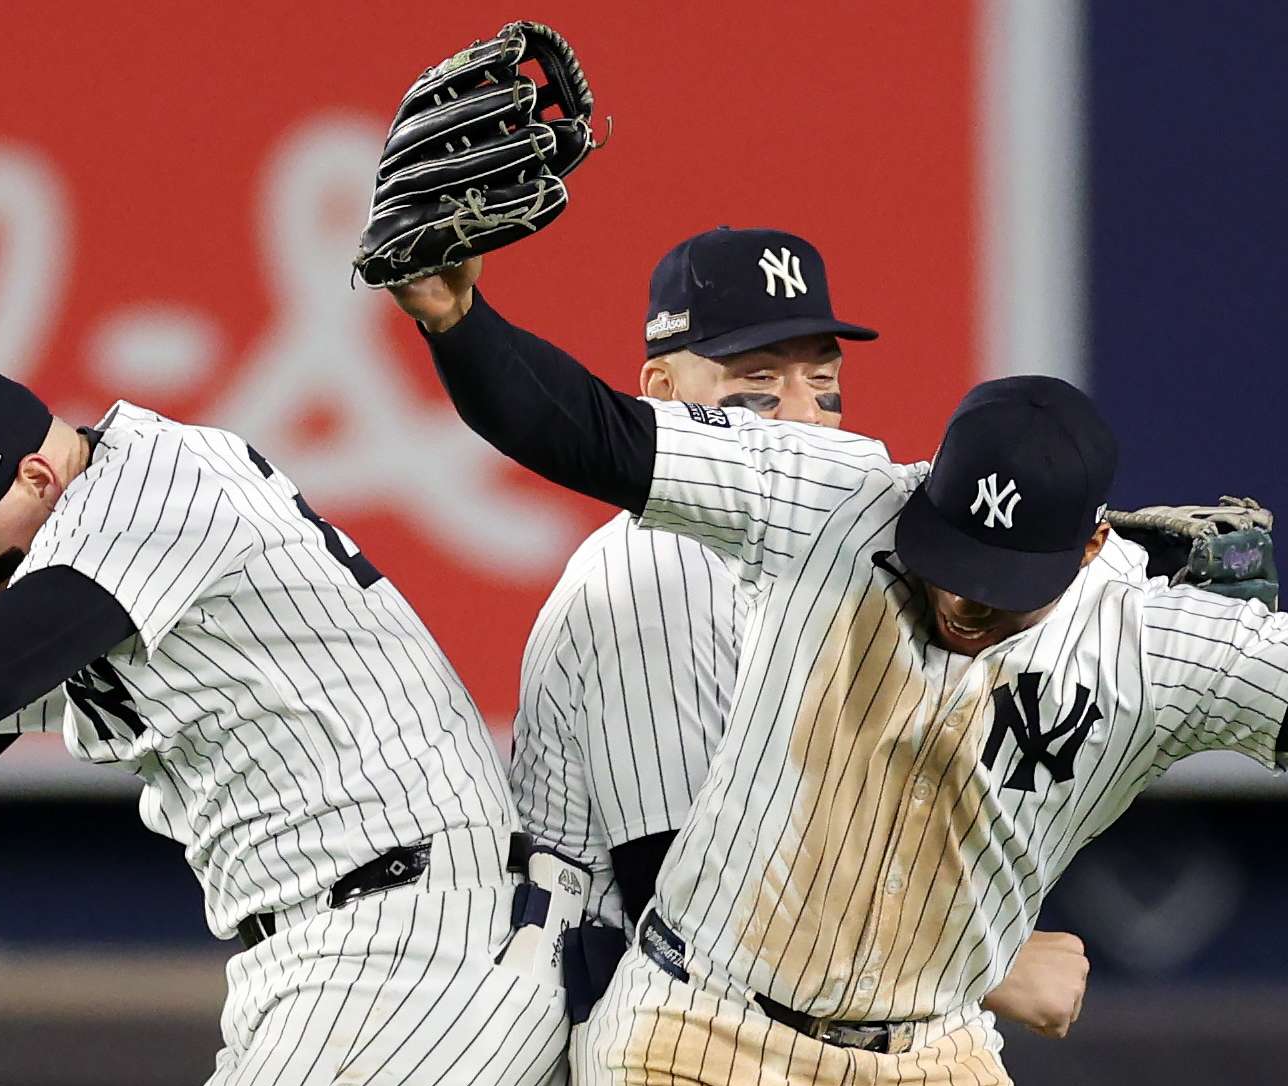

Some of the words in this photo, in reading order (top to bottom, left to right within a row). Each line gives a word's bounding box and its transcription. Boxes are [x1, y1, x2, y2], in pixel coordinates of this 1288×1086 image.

[758, 247, 808, 298] NY
[970, 472, 1022, 529] NY
[980, 671, 1104, 793] NY
